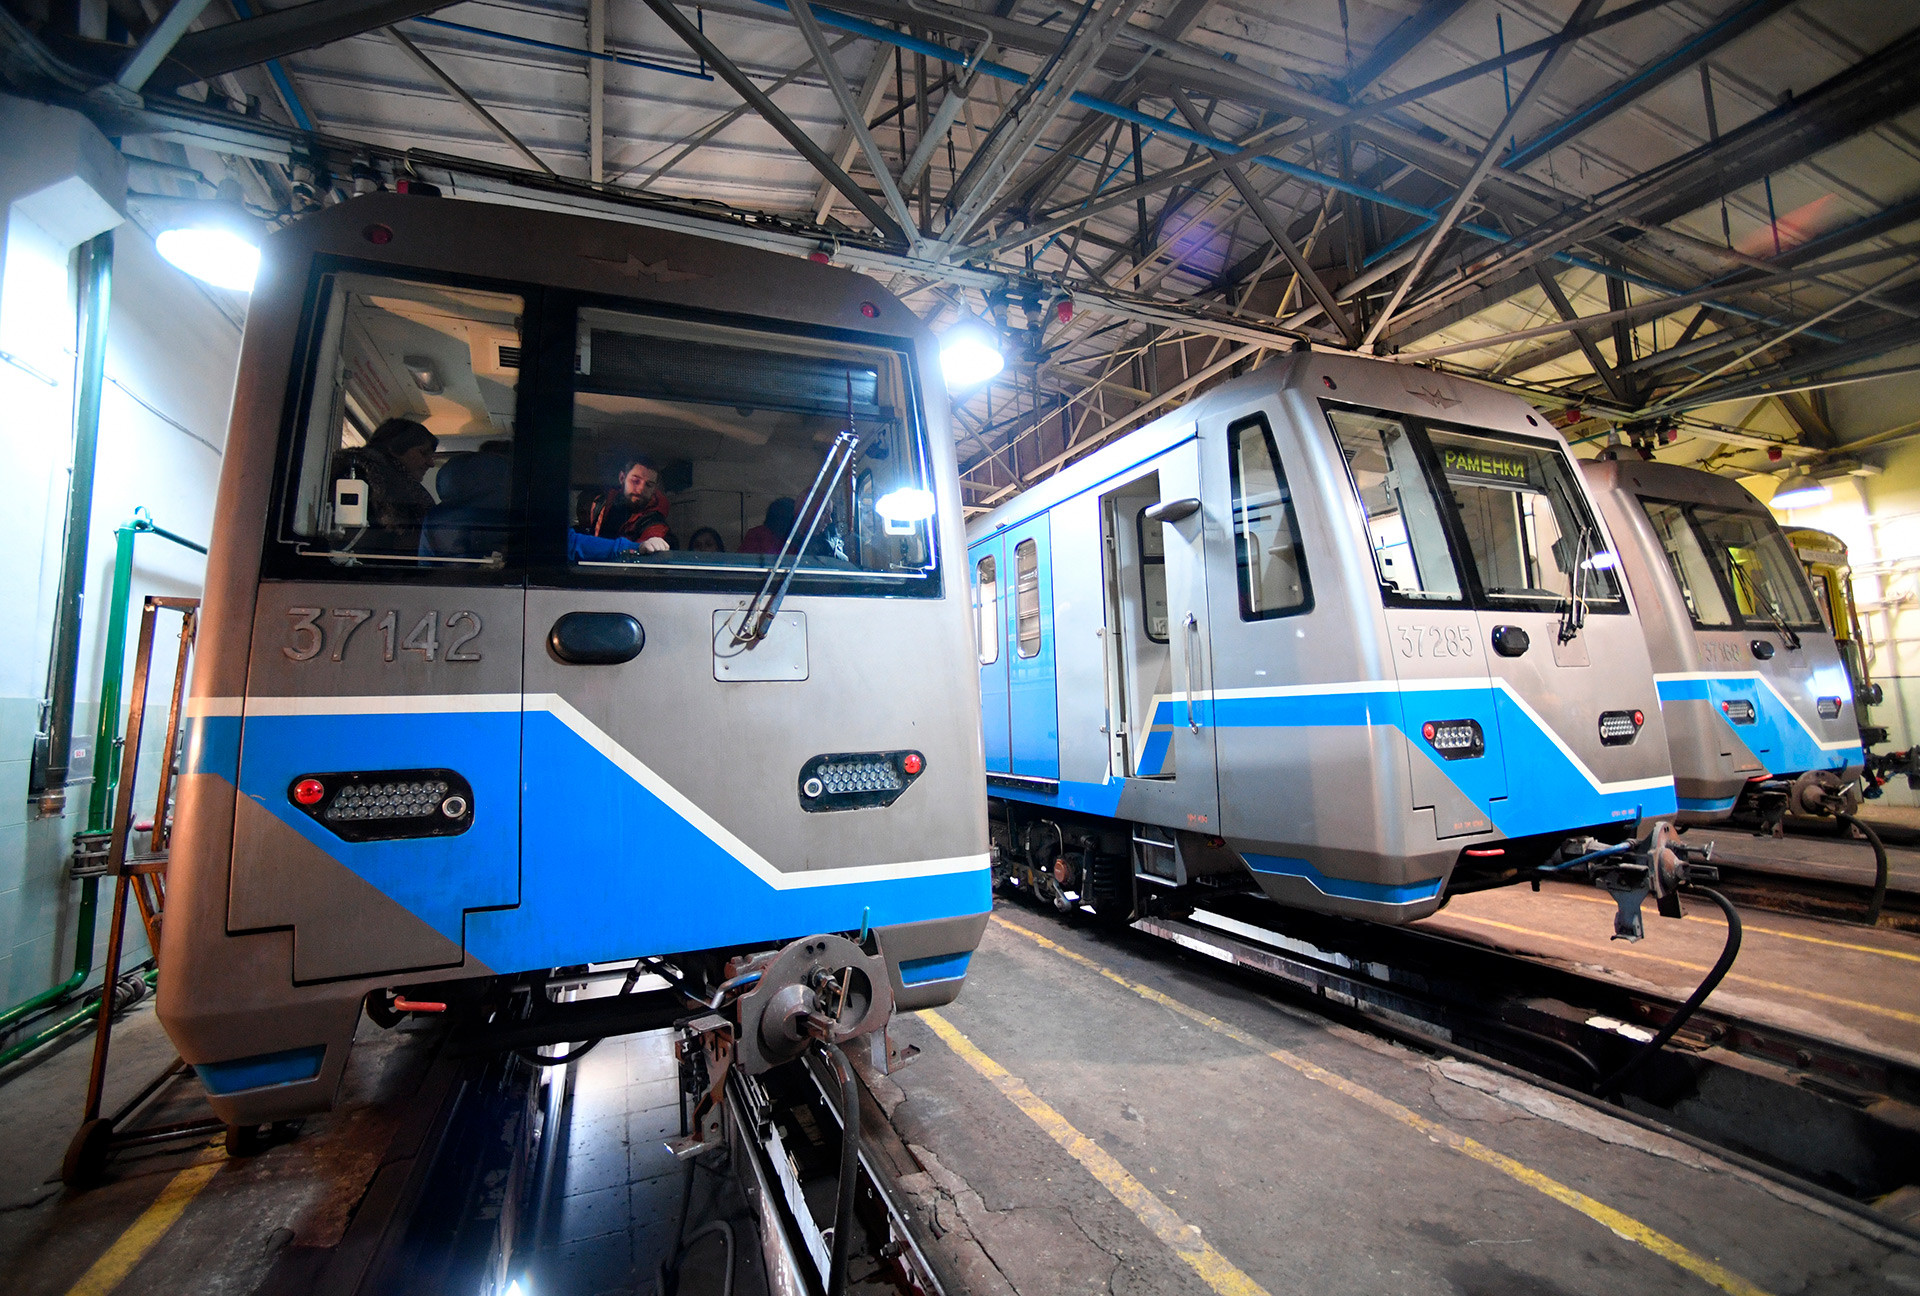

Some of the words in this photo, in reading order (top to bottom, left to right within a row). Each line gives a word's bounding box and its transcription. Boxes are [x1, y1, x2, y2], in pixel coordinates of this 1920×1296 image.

[1445, 450, 1525, 478] РАМЕНКИ
[283, 606, 482, 662] 37142
[1398, 625, 1473, 658] 37285
